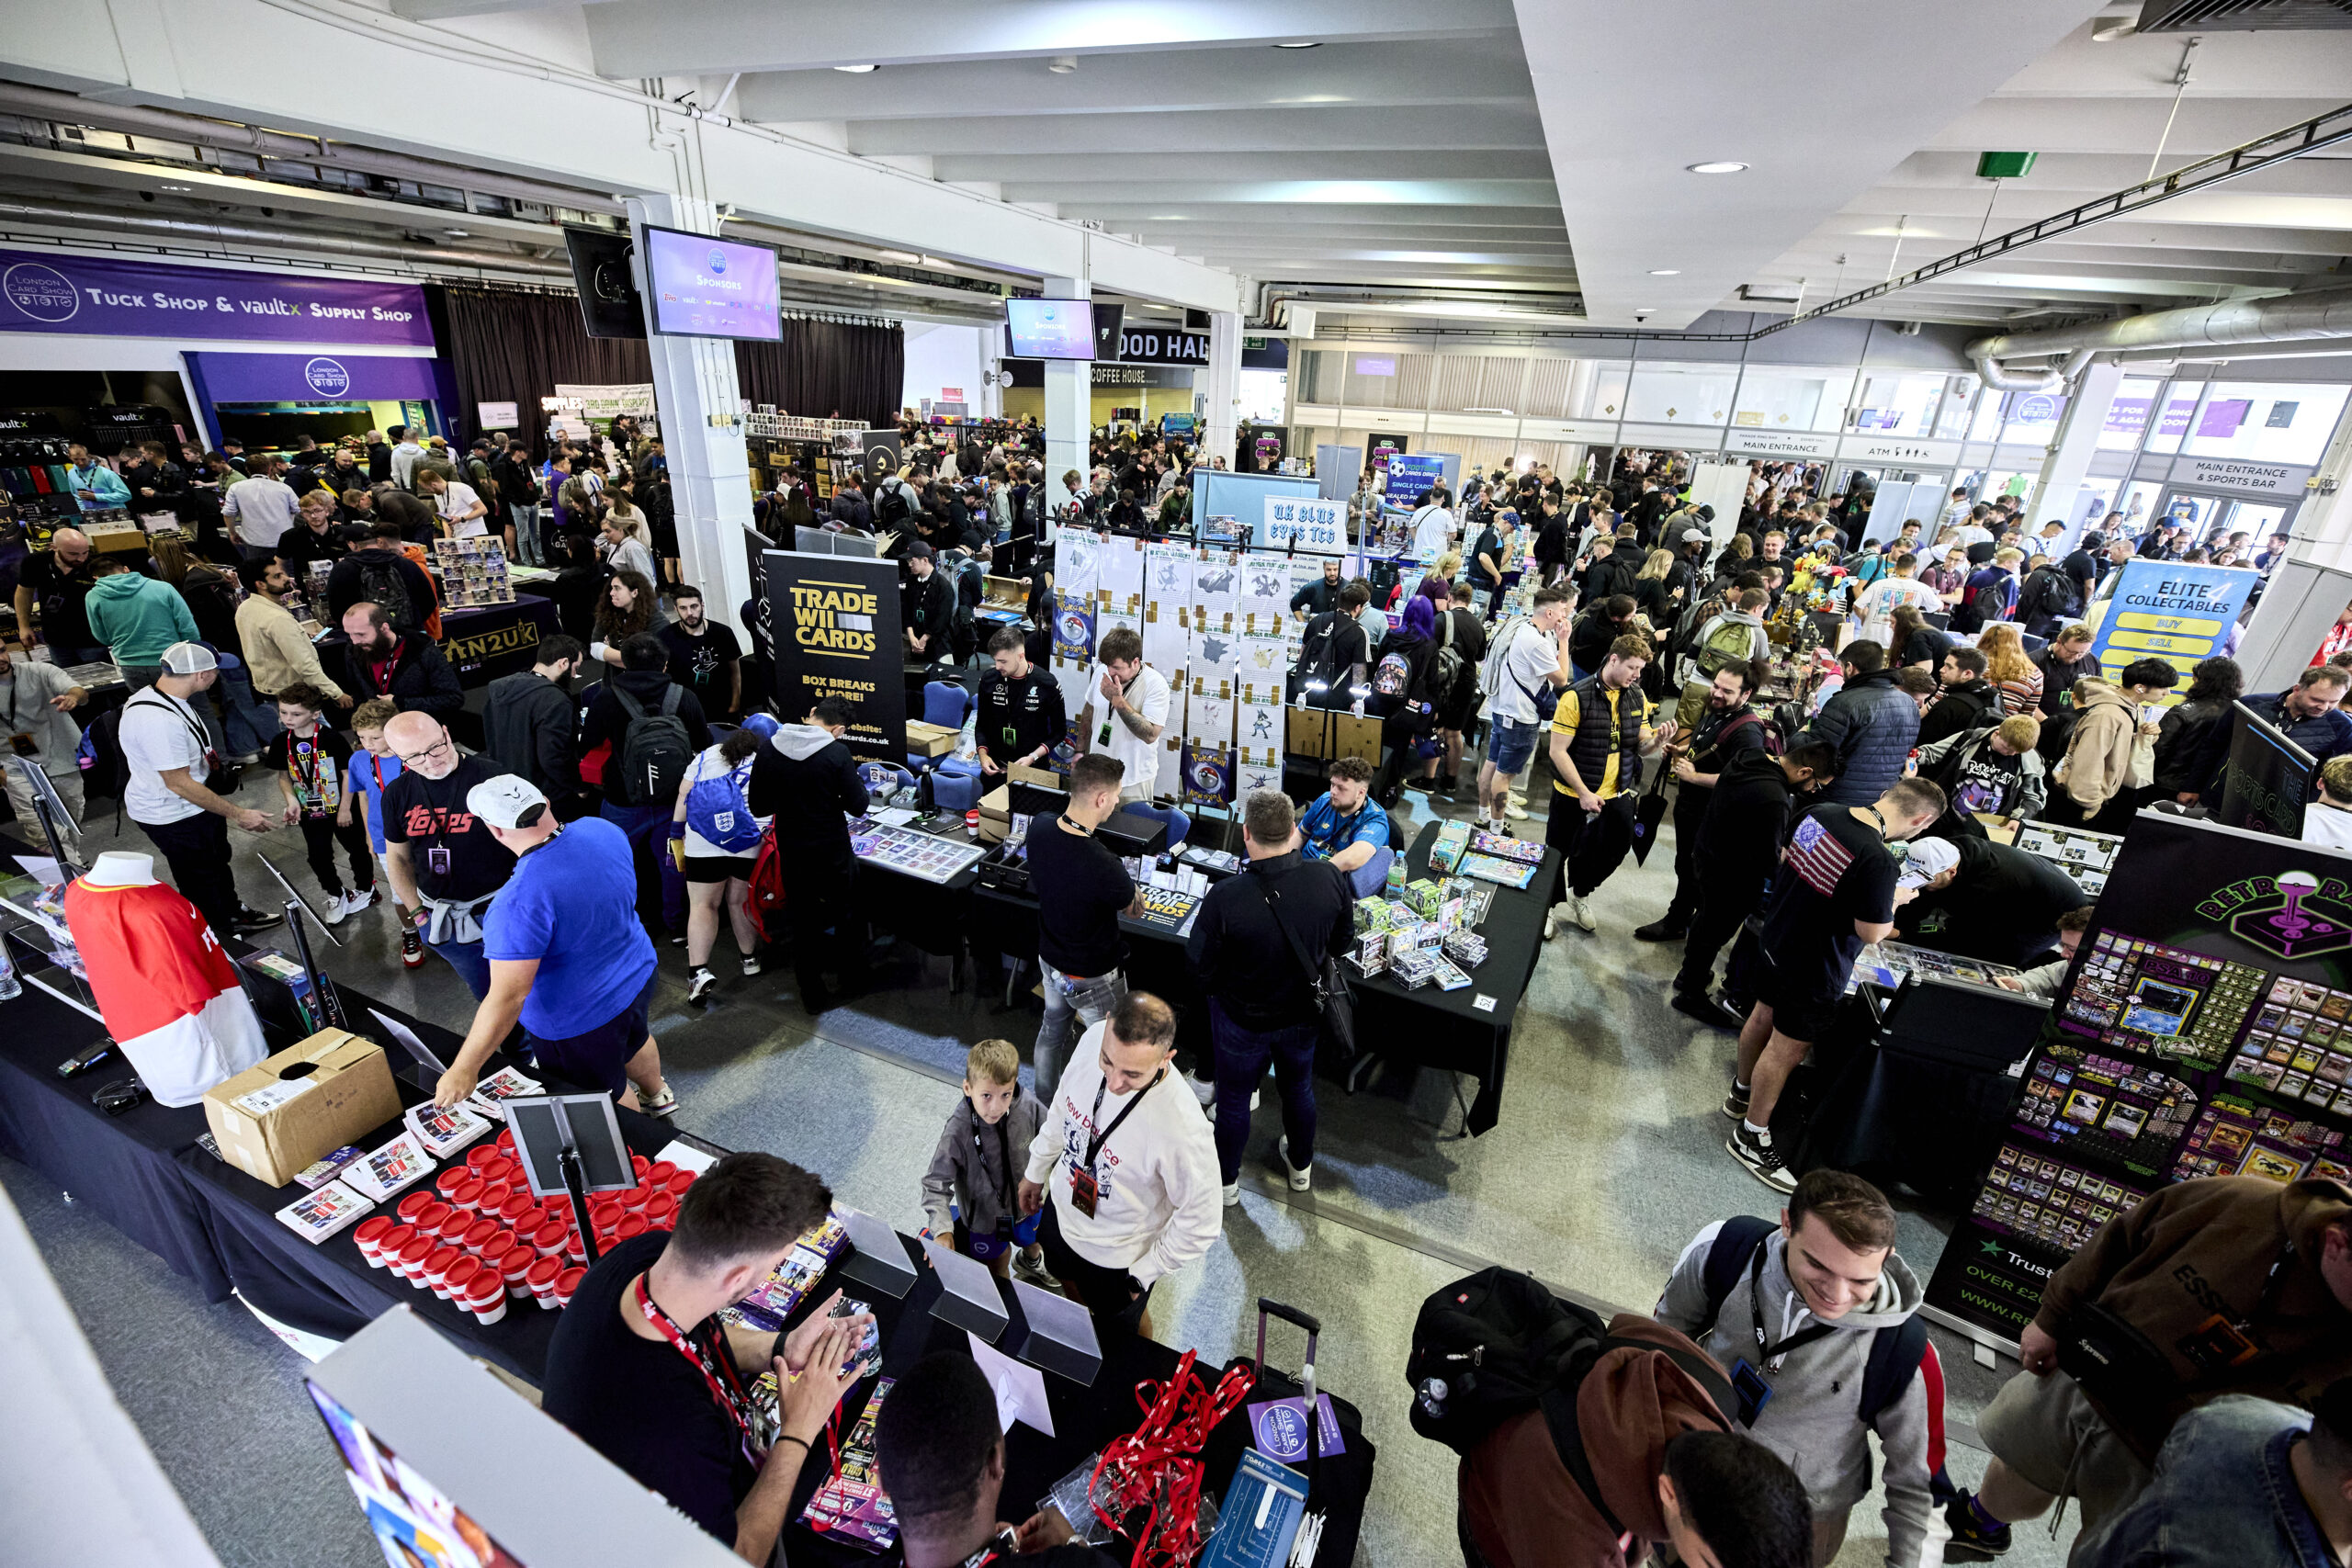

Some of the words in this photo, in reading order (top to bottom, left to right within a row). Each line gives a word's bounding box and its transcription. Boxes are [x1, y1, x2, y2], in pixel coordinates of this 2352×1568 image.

[7, 284, 38, 294] CARD
[40, 286, 74, 296] SHOW
[15, 276, 61, 287] LONDON
[85, 288, 147, 308] TUCK
[153, 292, 209, 310] SHOP
[216, 297, 234, 312] &
[309, 302, 366, 320] SUPPLY
[371, 306, 413, 322] SHOP
[1091, 367, 1120, 383] COFFEE
[1122, 369, 1145, 384] HOUSE
[2122, 406, 2144, 415] FOR
[0, 419, 28, 429] aultx
[2120, 416, 2146, 424] AGAI
[1743, 441, 1767, 450] MAIN
[1769, 443, 1818, 453] ENTRANCE
[1406, 464, 1441, 472] FOOTBALL
[2196, 462, 2222, 472] MAIN
[2226, 465, 2288, 479] ENTRANCE
[2197, 473, 2204, 481] &
[2207, 474, 2249, 486] SPORTS
[2251, 479, 2276, 489] BAR
[1273, 504, 1295, 521] UK
[1298, 506, 1336, 525] BLUE
[1311, 526, 1336, 544] TCG
[789, 587, 877, 615] TRADE
[2158, 581, 2212, 598] ELITE
[2209, 582, 2233, 605] 4
[2125, 594, 2231, 614] COLLECTABLES
[794, 607, 834, 629] WII
[2156, 618, 2182, 629] BUY
[795, 626, 876, 652] CARDS
[2146, 637, 2172, 648] SELL
[802, 675, 827, 687] BOX
[829, 678, 876, 692] BREAKS
[815, 689, 824, 697] &
[848, 724, 882, 734] ebsite:
[837, 735, 889, 745] wiicards.co.uk
[1139, 885, 1197, 904] TRADE
[1144, 901, 1188, 918] ARDS
[1066, 1096, 1081, 1120] new
[1082, 1115, 1119, 1166] balnce
[2007, 1251, 2054, 1279] Trust
[1966, 1266, 2014, 1292] OVER
[1961, 1289, 2033, 1325] WWW.RE
[1274, 1408, 1284, 1430] SHOW
[1269, 1416, 1282, 1447] LONDON
[1281, 1432, 1290, 1453] CARD
[841, 1463, 864, 1477] GOLD
[864, 1486, 876, 1498] 31
